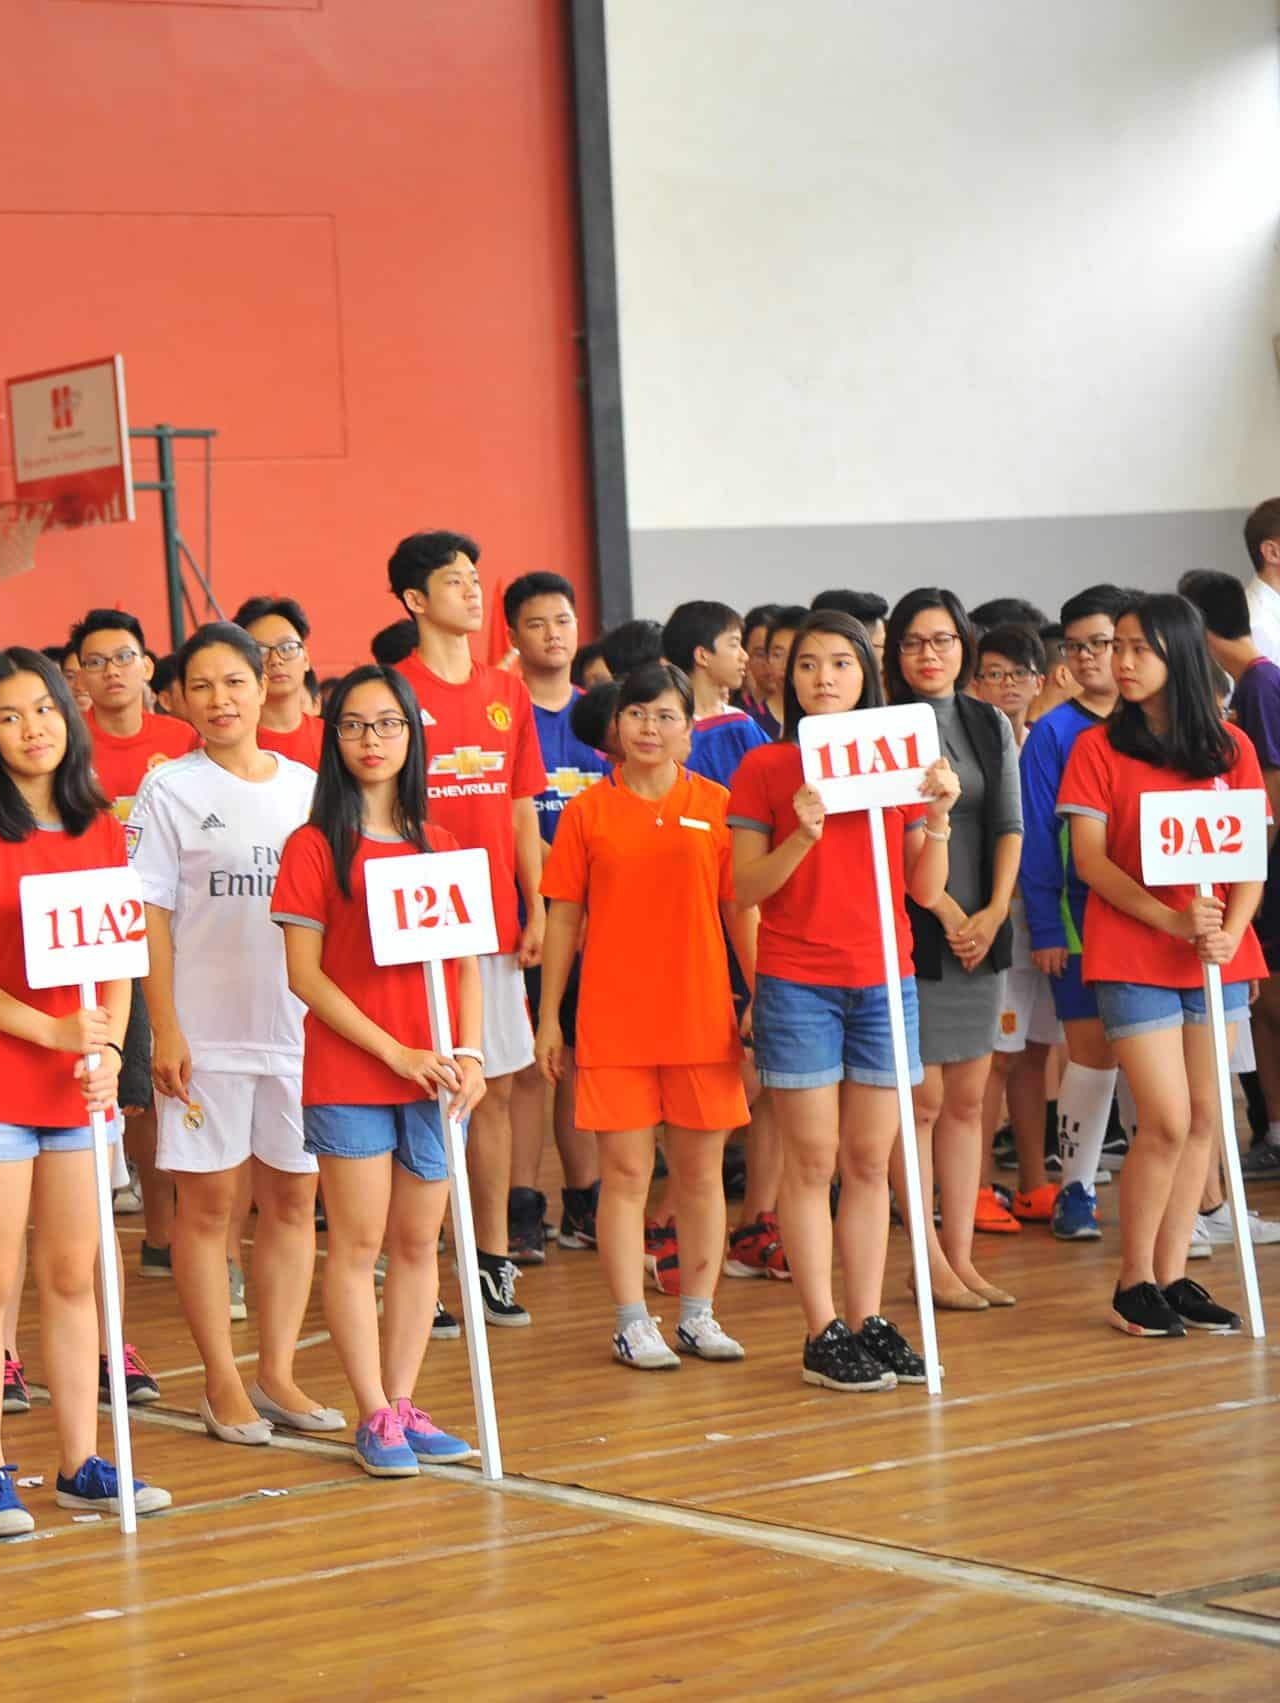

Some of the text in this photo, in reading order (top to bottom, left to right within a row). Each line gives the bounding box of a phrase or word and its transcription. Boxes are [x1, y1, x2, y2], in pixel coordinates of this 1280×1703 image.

[812, 732, 927, 780] 11A1
[427, 782, 507, 799] CHEVROLET
[1159, 815, 1244, 856] 9A2
[45, 899, 149, 950] 11A2
[392, 884, 472, 931] 12A
